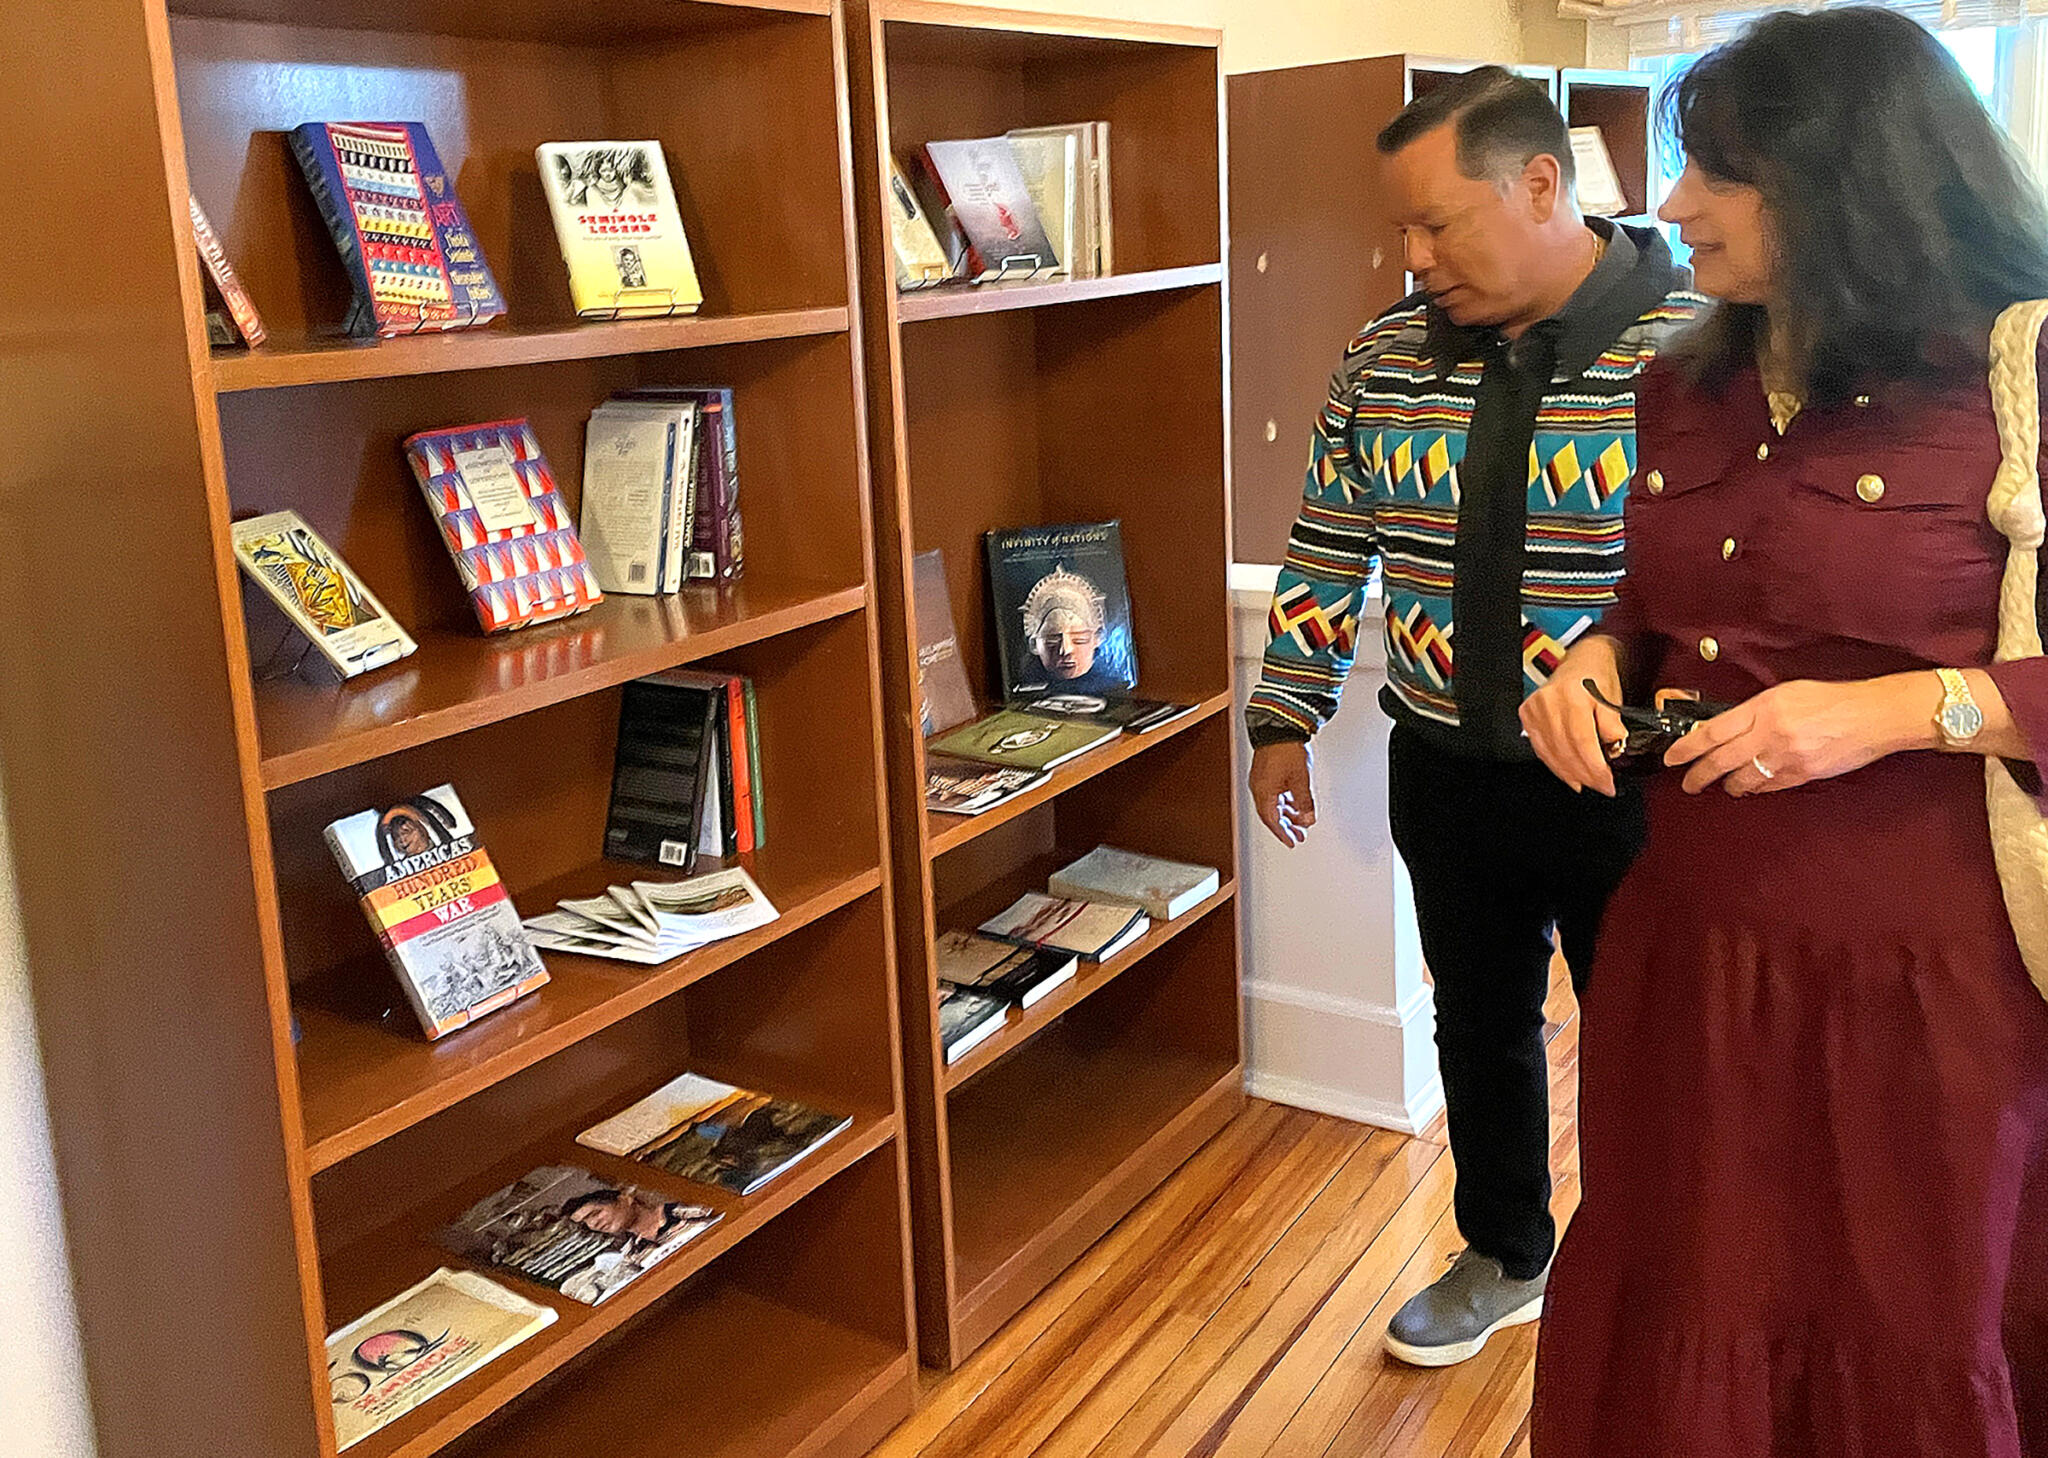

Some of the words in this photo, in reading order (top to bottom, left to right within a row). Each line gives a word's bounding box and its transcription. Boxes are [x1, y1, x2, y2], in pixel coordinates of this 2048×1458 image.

[577, 213, 658, 225] SEMINOLE
[589, 224, 651, 234] LEGEND
[207, 241, 234, 283] TRAIL
[1001, 535, 1051, 550] INFINITY
[1061, 529, 1109, 544] NATIONS
[392, 855, 477, 900] HUNDRED
[432, 897, 475, 925] WAR
